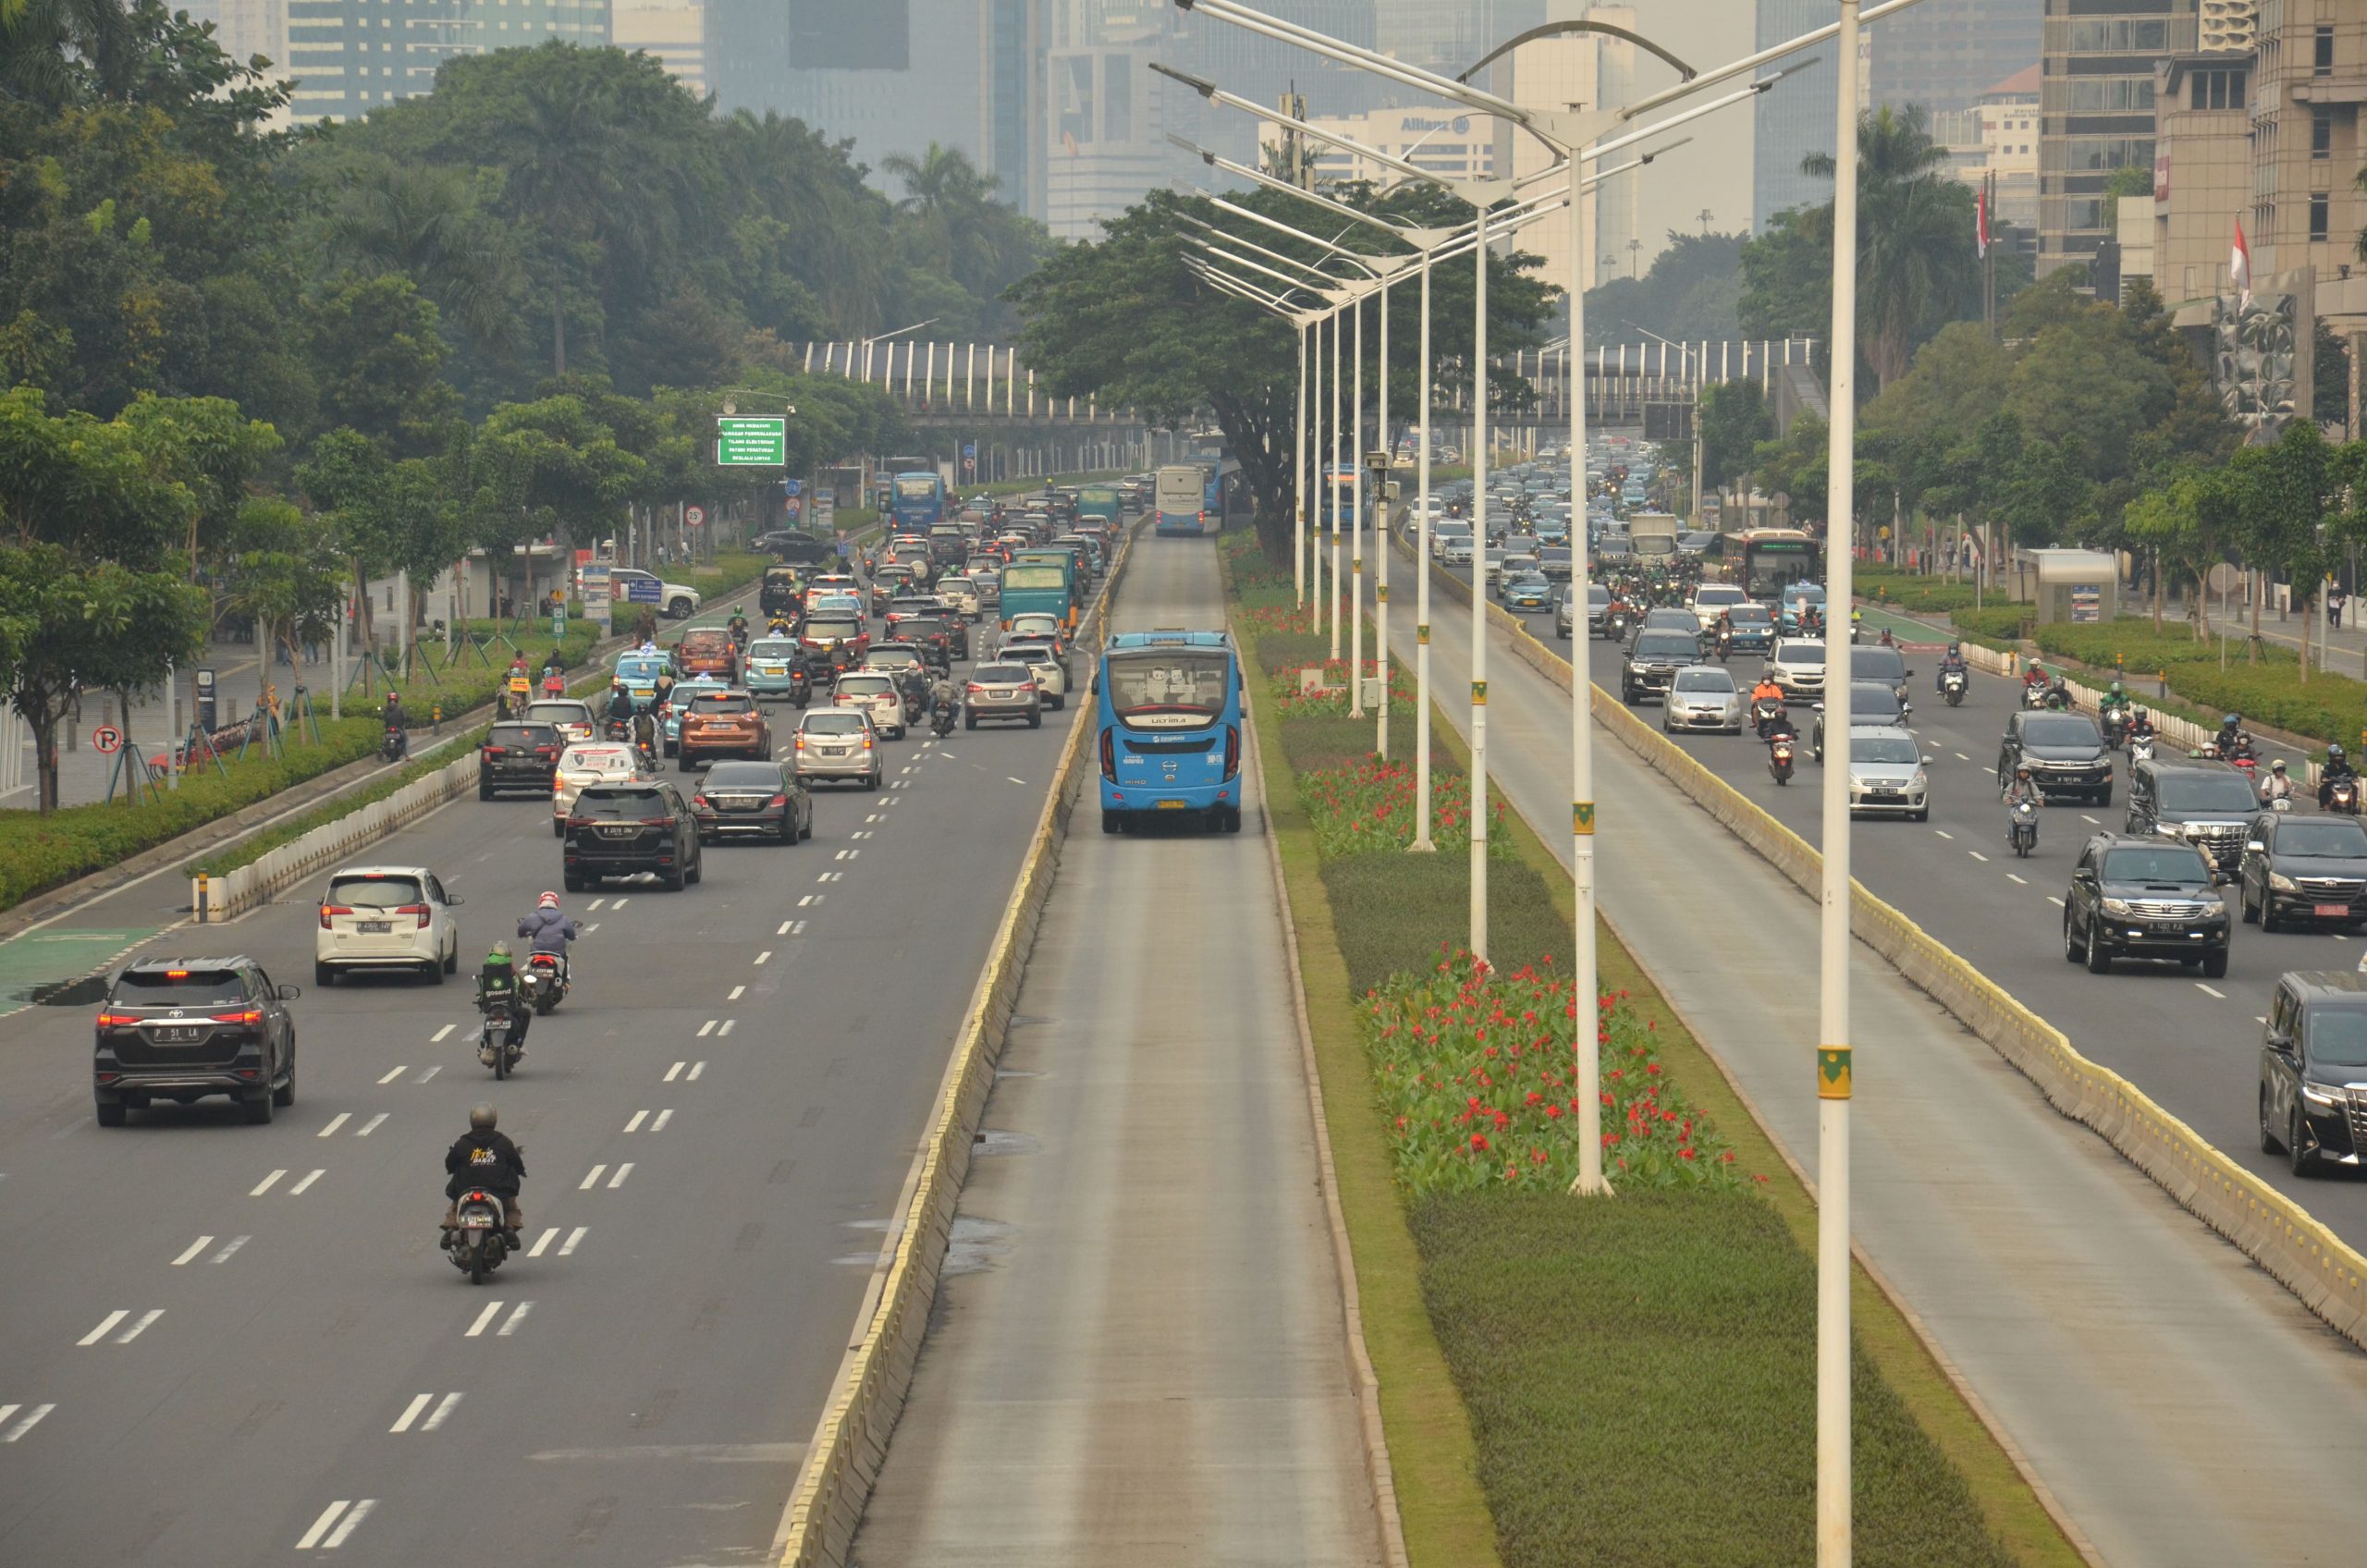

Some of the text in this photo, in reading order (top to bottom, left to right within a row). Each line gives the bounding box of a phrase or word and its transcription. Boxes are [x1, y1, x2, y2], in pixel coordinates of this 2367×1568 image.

[1401, 117, 1450, 131] Allianz
[102, 730, 117, 749] P
[485, 988, 511, 998] gosend
[188, 1028, 198, 1036] LA
